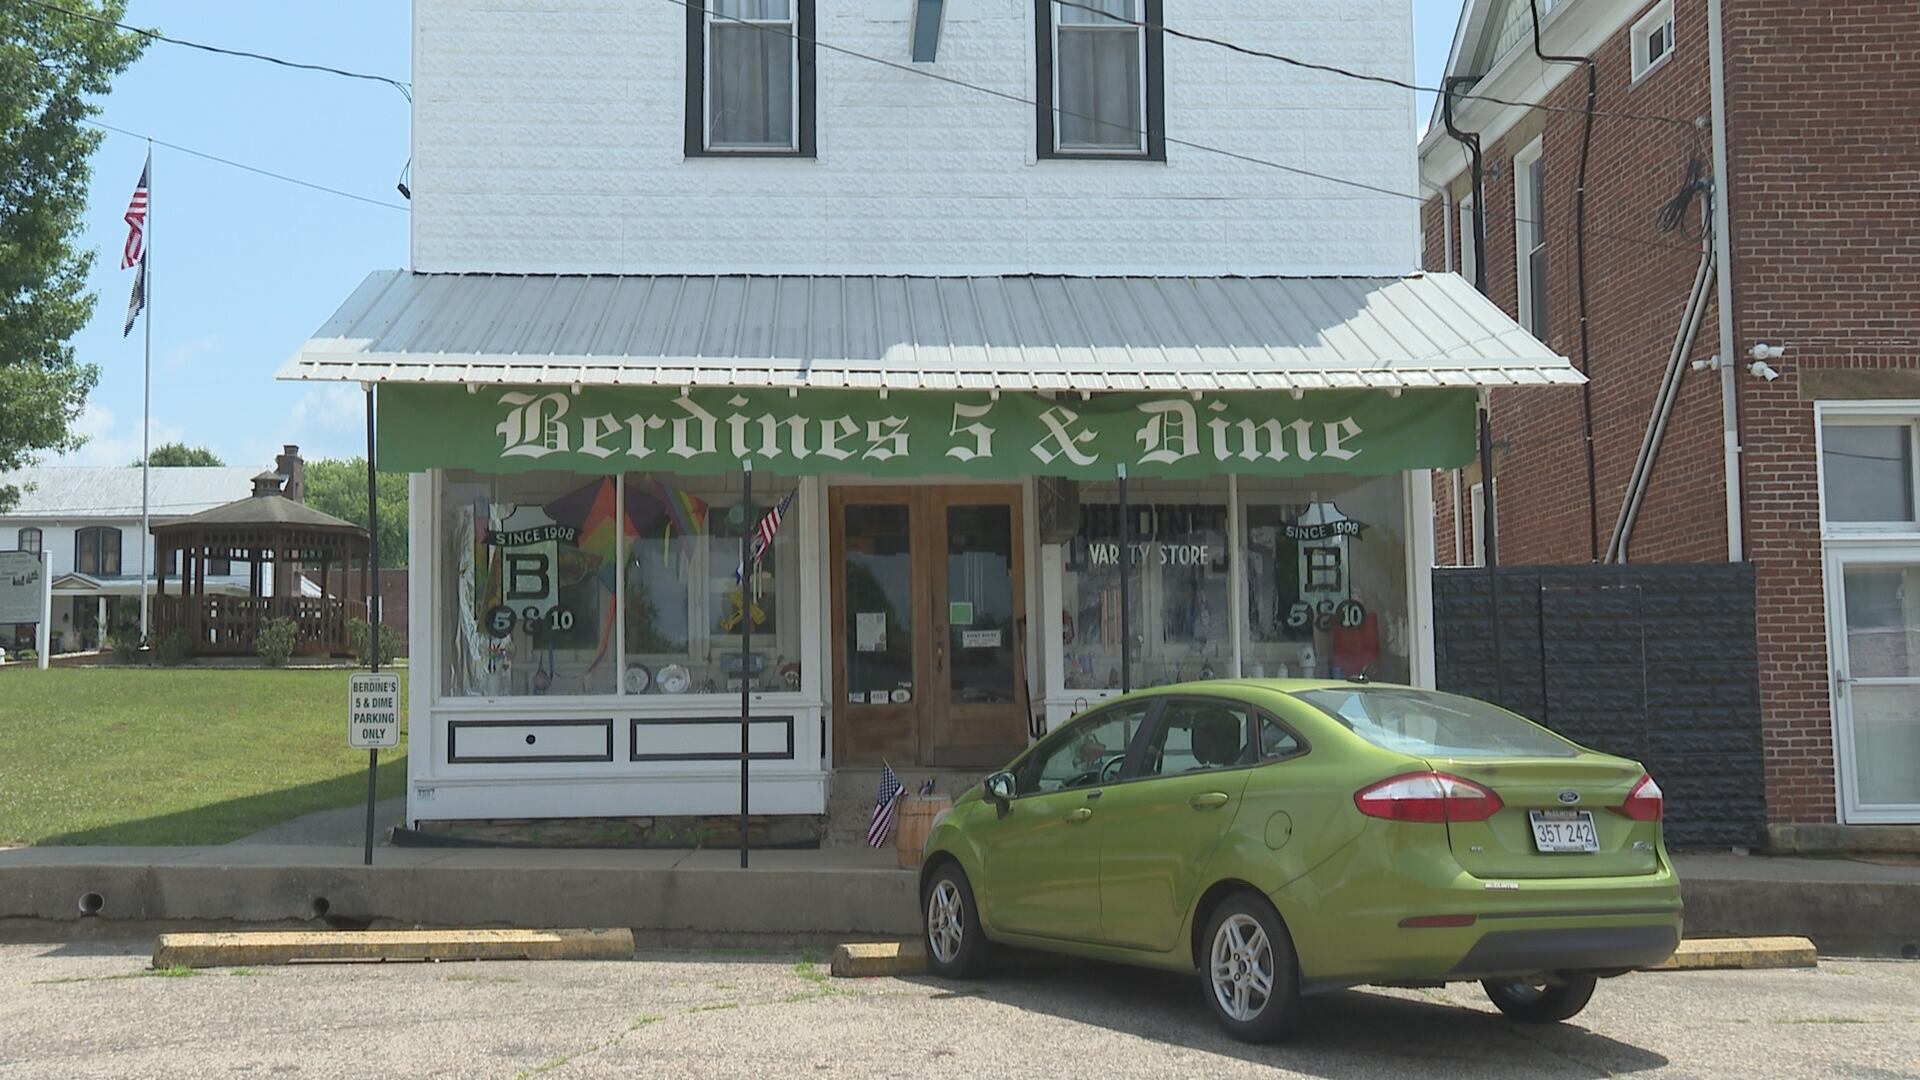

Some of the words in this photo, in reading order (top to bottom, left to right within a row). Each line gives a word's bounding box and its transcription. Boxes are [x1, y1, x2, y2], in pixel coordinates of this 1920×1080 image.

[496, 391, 910, 461] Berdines
[945, 401, 996, 463] 5
[1029, 405, 1100, 466] &
[1135, 400, 1363, 465] Dime
[495, 528, 541, 545] SINCE
[543, 526, 576, 541] 1908
[1285, 524, 1327, 540] SINCE
[1332, 521, 1360, 536] 1908
[1088, 543, 1150, 566] VARTY
[1160, 544, 1209, 566] STORE
[505, 553, 550, 601] B
[1303, 546, 1342, 593] B
[492, 611, 512, 631] 5
[550, 610, 575, 631] 10
[1287, 603, 1309, 627] 5
[1341, 604, 1363, 628] 10
[353, 682, 396, 693] BERDINE'S
[355, 697, 361, 708] 5
[363, 697, 370, 708] &
[372, 697, 393, 708] DIME
[353, 713, 395, 724] PARKING
[362, 728, 386, 740] ONLY
[1537, 823, 1562, 843] 35T
[1565, 823, 1593, 843] 242
